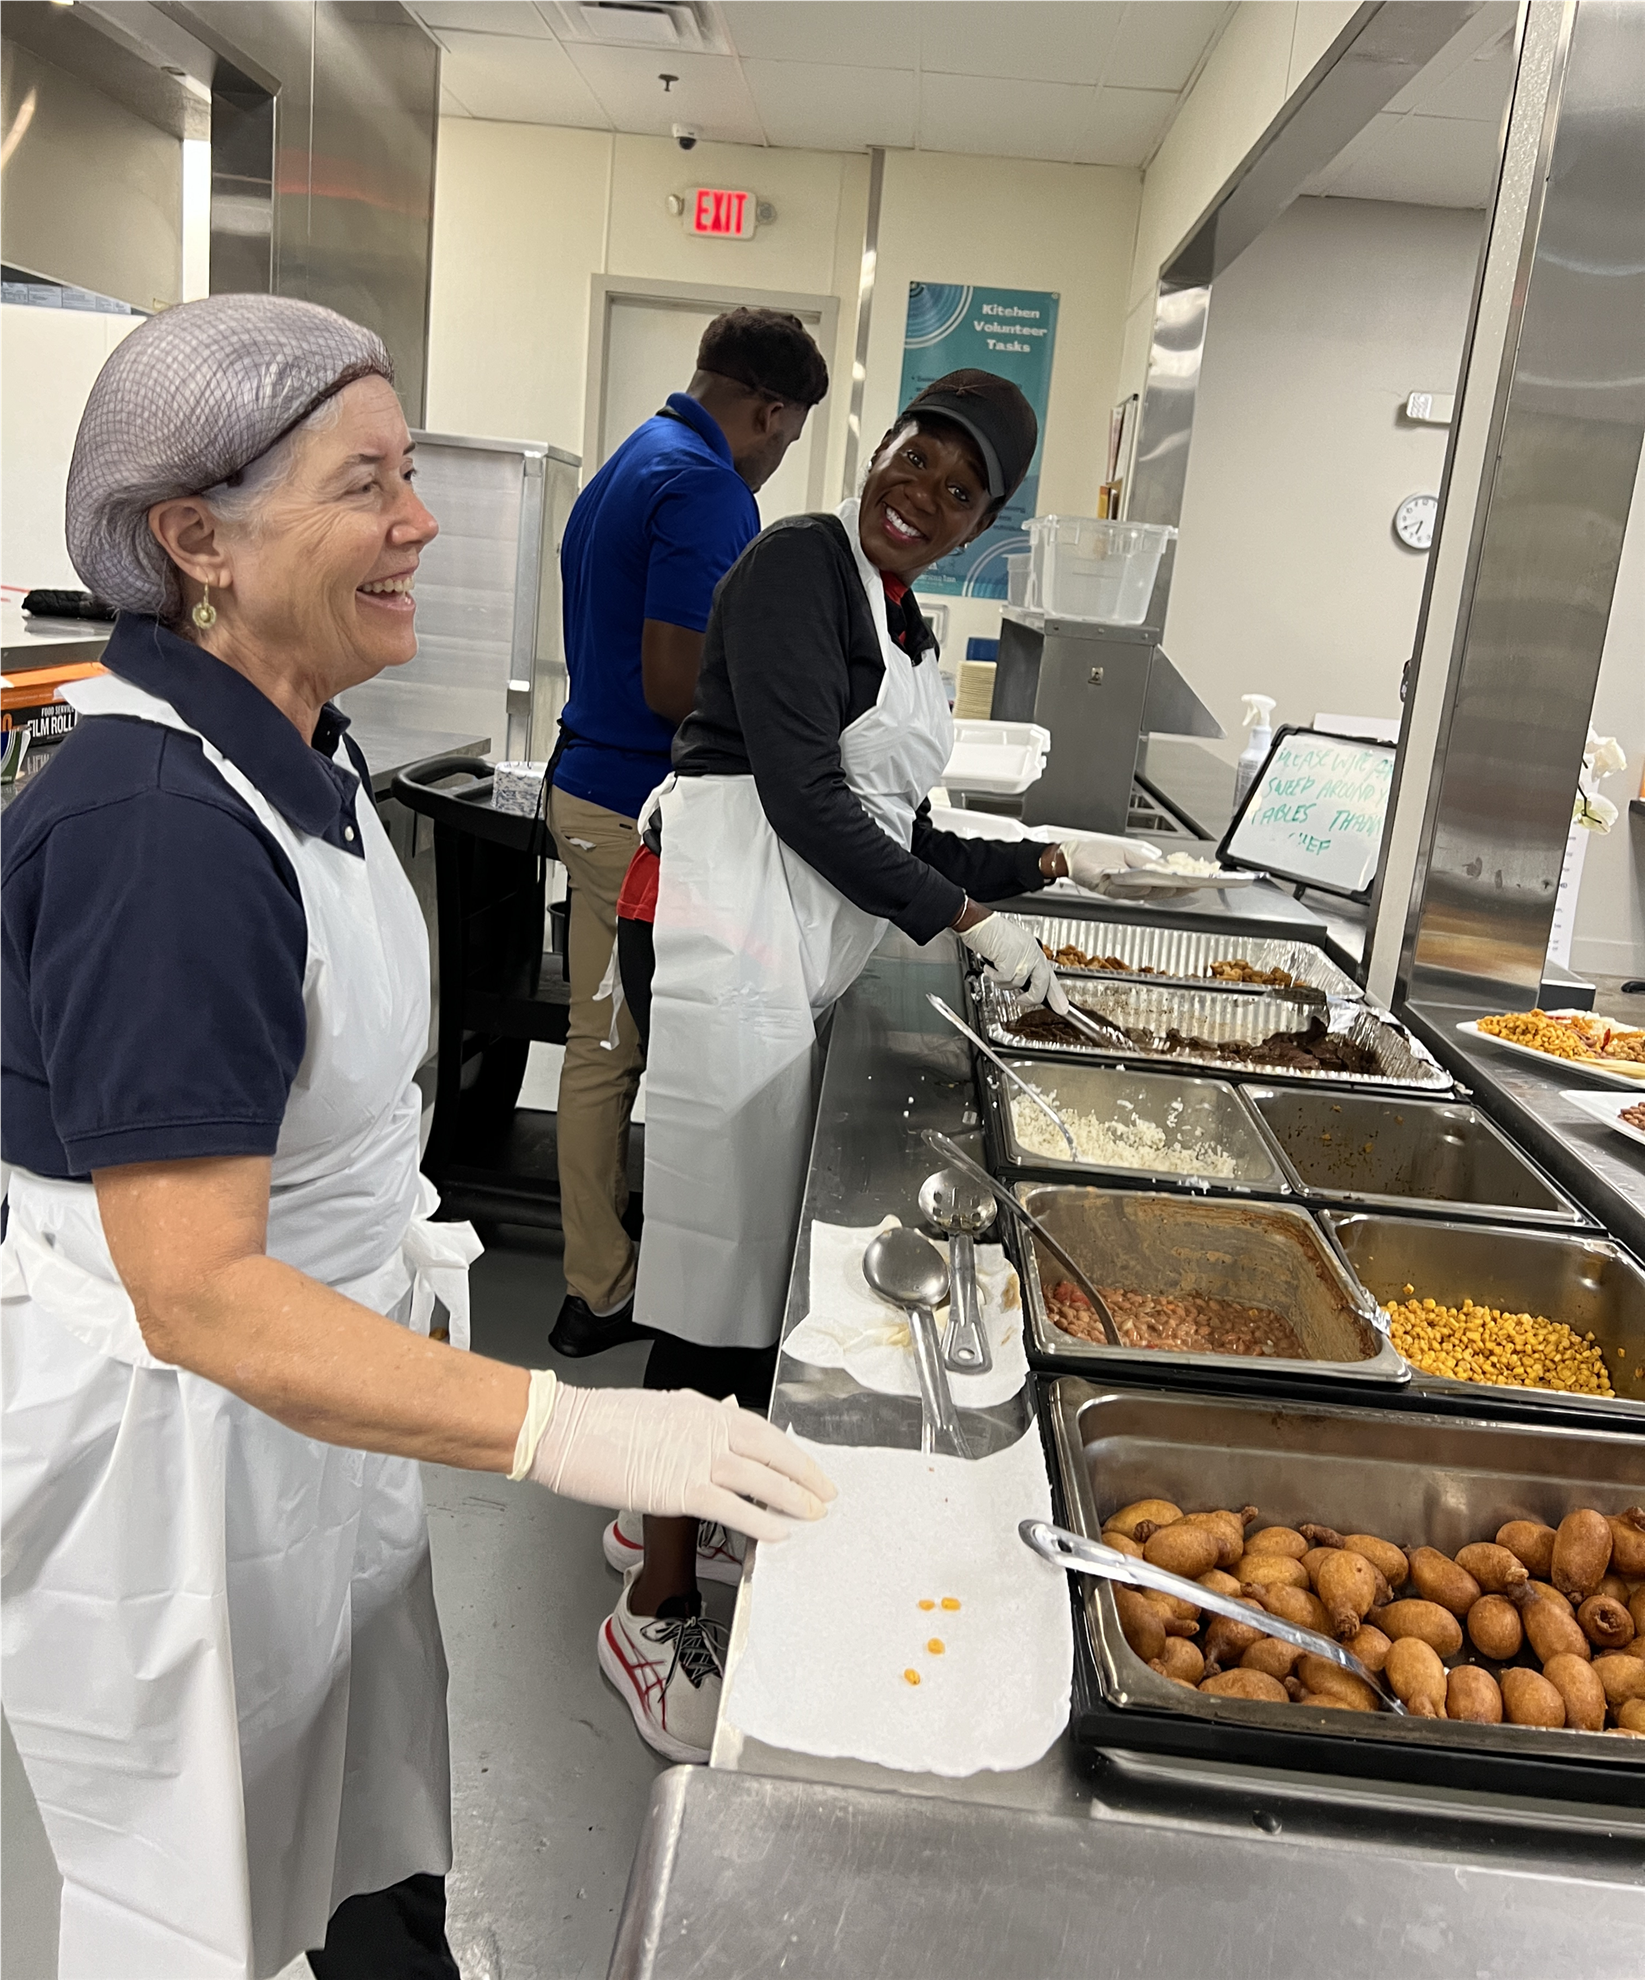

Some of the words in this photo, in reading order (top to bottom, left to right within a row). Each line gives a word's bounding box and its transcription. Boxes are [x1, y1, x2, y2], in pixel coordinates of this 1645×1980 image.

[694, 187, 749, 235] EXIT
[982, 303, 1040, 319] Kitchen
[973, 320, 1048, 337] Volunteer
[986, 338, 1031, 353] Tasks
[41, 706, 54, 717] FOOD
[27, 717, 50, 738] FILM
[50, 713, 73, 735] ROLL
[1265, 775, 1315, 798] SWEEP
[1316, 779, 1375, 803] AROUND
[1251, 803, 1317, 825] TABLES
